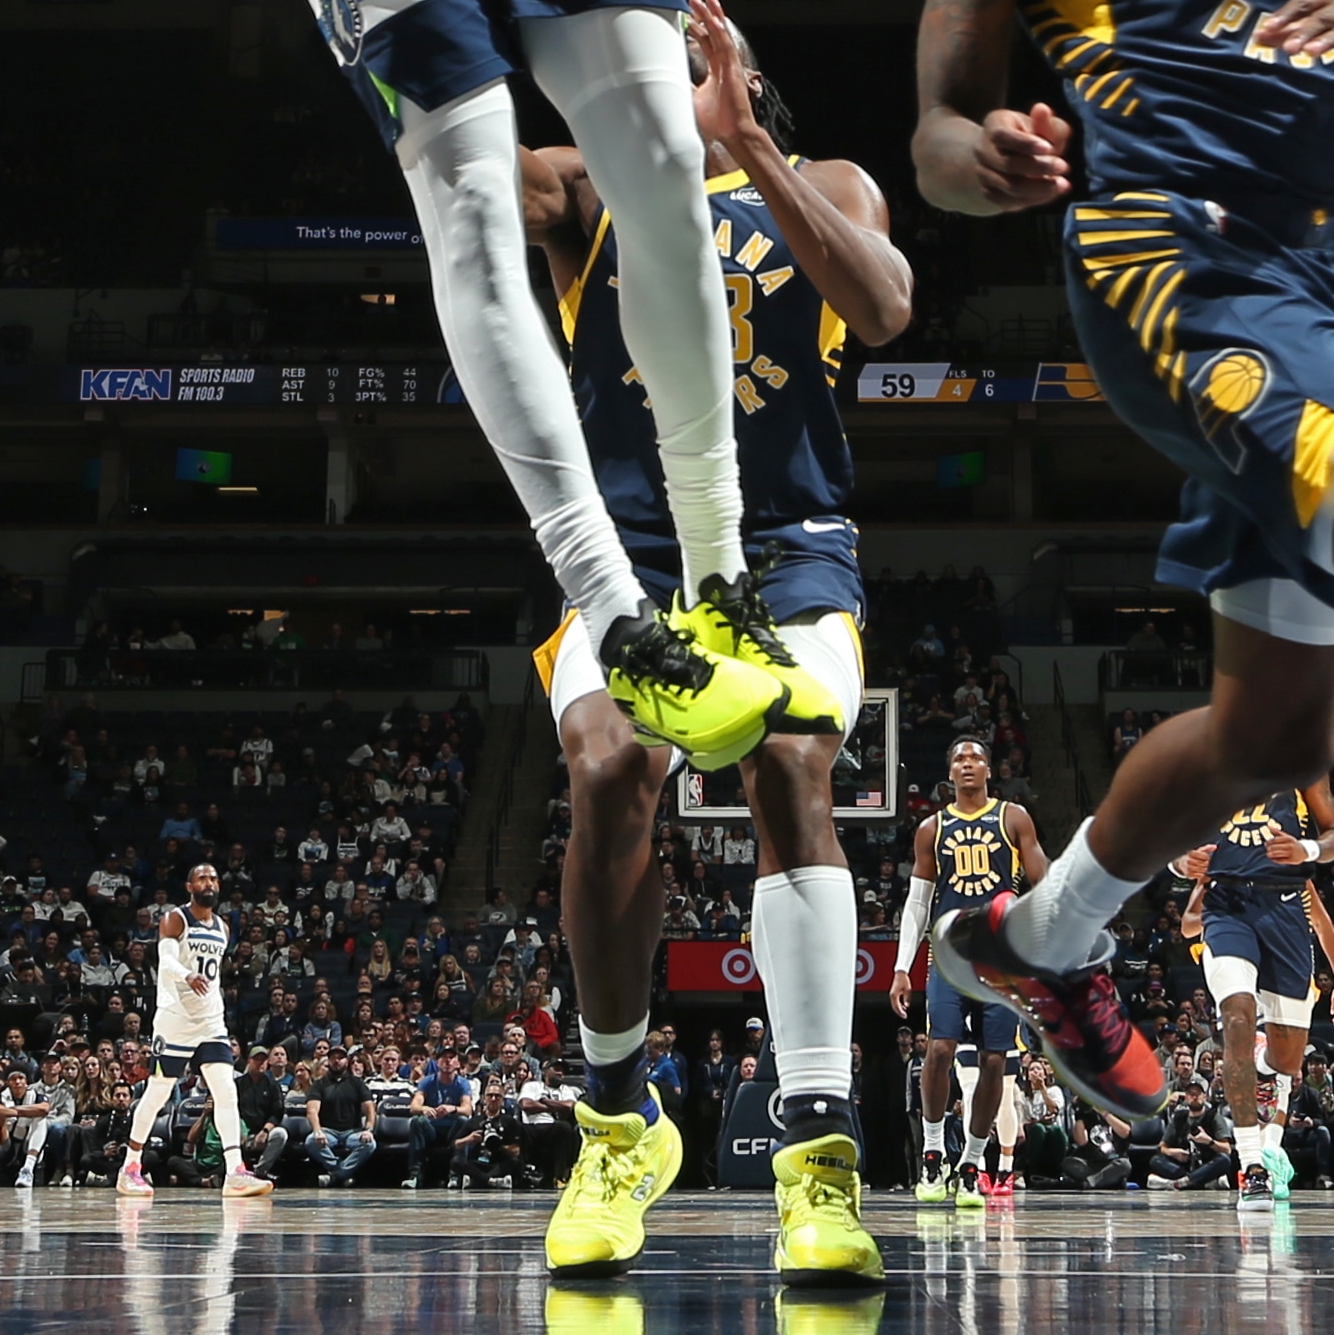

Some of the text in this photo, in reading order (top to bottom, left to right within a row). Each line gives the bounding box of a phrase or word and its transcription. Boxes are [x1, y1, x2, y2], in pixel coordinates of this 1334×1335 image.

[296, 226, 336, 239] That's
[339, 227, 361, 239] the
[365, 231, 407, 243] power
[179, 369, 255, 383] SPORTS RADIO
[282, 368, 306, 378] REB
[326, 368, 339, 377] 10
[359, 368, 385, 378] FG%
[949, 370, 995, 378] FLS TO
[80, 369, 171, 401] KFAN
[282, 379, 417, 390] AST 9 FT% 70
[881, 373, 916, 398] 59
[952, 384, 994, 397] 4 6
[177, 387, 224, 401] FM 100.3
[282, 392, 305, 402] STL
[328, 393, 335, 402] 3
[402, 392, 416, 402] 35
[941, 826, 1002, 856] INDIANA
[954, 844, 990, 877] 00
[948, 870, 1001, 897] PACERS
[188, 942, 223, 956] WOLVE
[197, 955, 218, 981] 10
